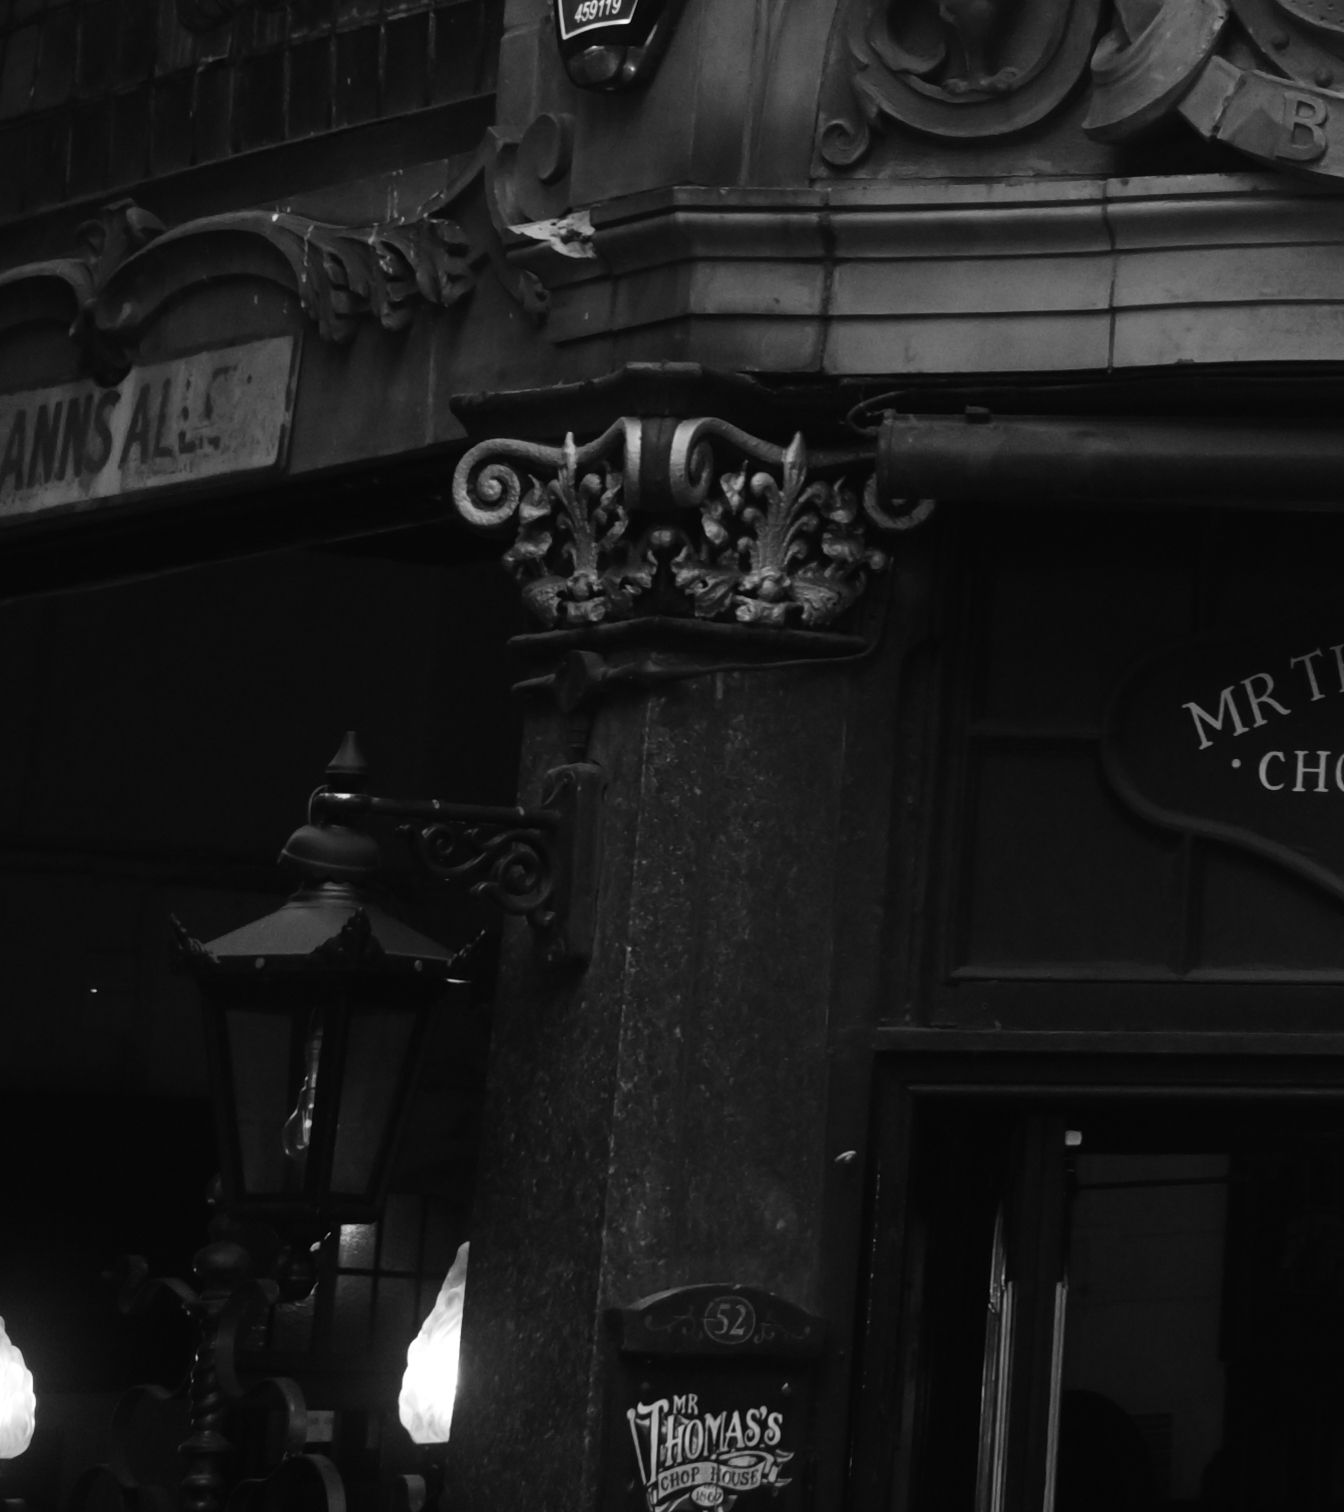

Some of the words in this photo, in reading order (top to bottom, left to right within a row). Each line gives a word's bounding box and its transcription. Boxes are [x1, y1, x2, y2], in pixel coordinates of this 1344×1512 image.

[1181, 671, 1291, 750] MR
[715, 1303, 747, 1336] 52
[672, 1393, 699, 1415] MR
[636, 1398, 784, 1483] THOMAS'S
[660, 1466, 699, 1491] CHOP
[710, 1466, 759, 1485] HOUSE
